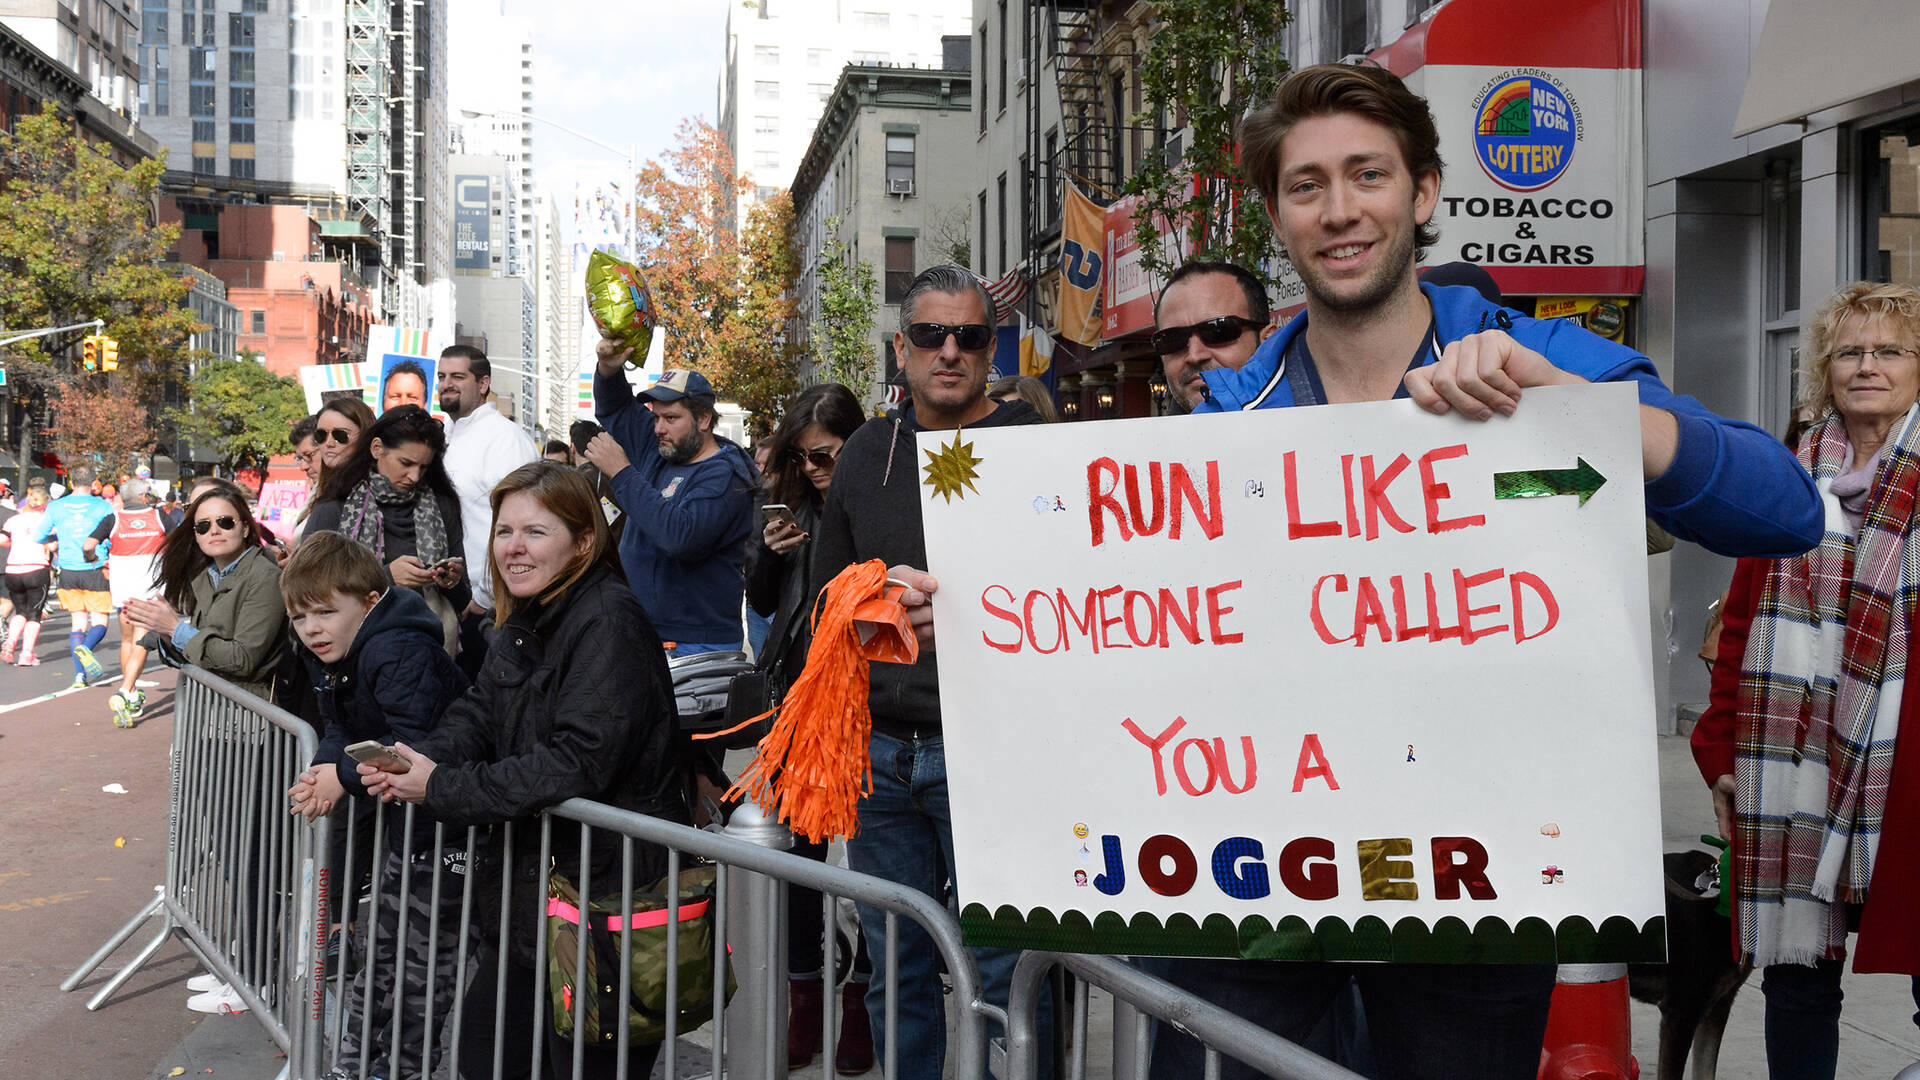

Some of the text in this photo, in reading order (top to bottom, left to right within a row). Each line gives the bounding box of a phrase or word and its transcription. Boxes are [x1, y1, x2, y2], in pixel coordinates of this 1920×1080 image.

[1472, 68, 1584, 142] EDUCATING LEADERS OF TOMORROW
[1532, 87, 1567, 117] NEW
[1532, 109, 1569, 132] YORK
[1487, 143, 1564, 174] LOTTERY
[1442, 197, 1614, 220] TOBACCO
[457, 223, 472, 232] THE
[1515, 221, 1536, 240] &
[457, 241, 488, 251] RENTALS
[1461, 242, 1595, 265] CIGARS
[1086, 443, 1486, 548] RUN LIKE
[981, 567, 1560, 654] SOMEONE CALLED
[1121, 716, 1340, 797] YOU A
[1093, 834, 1498, 901] JOGGER
